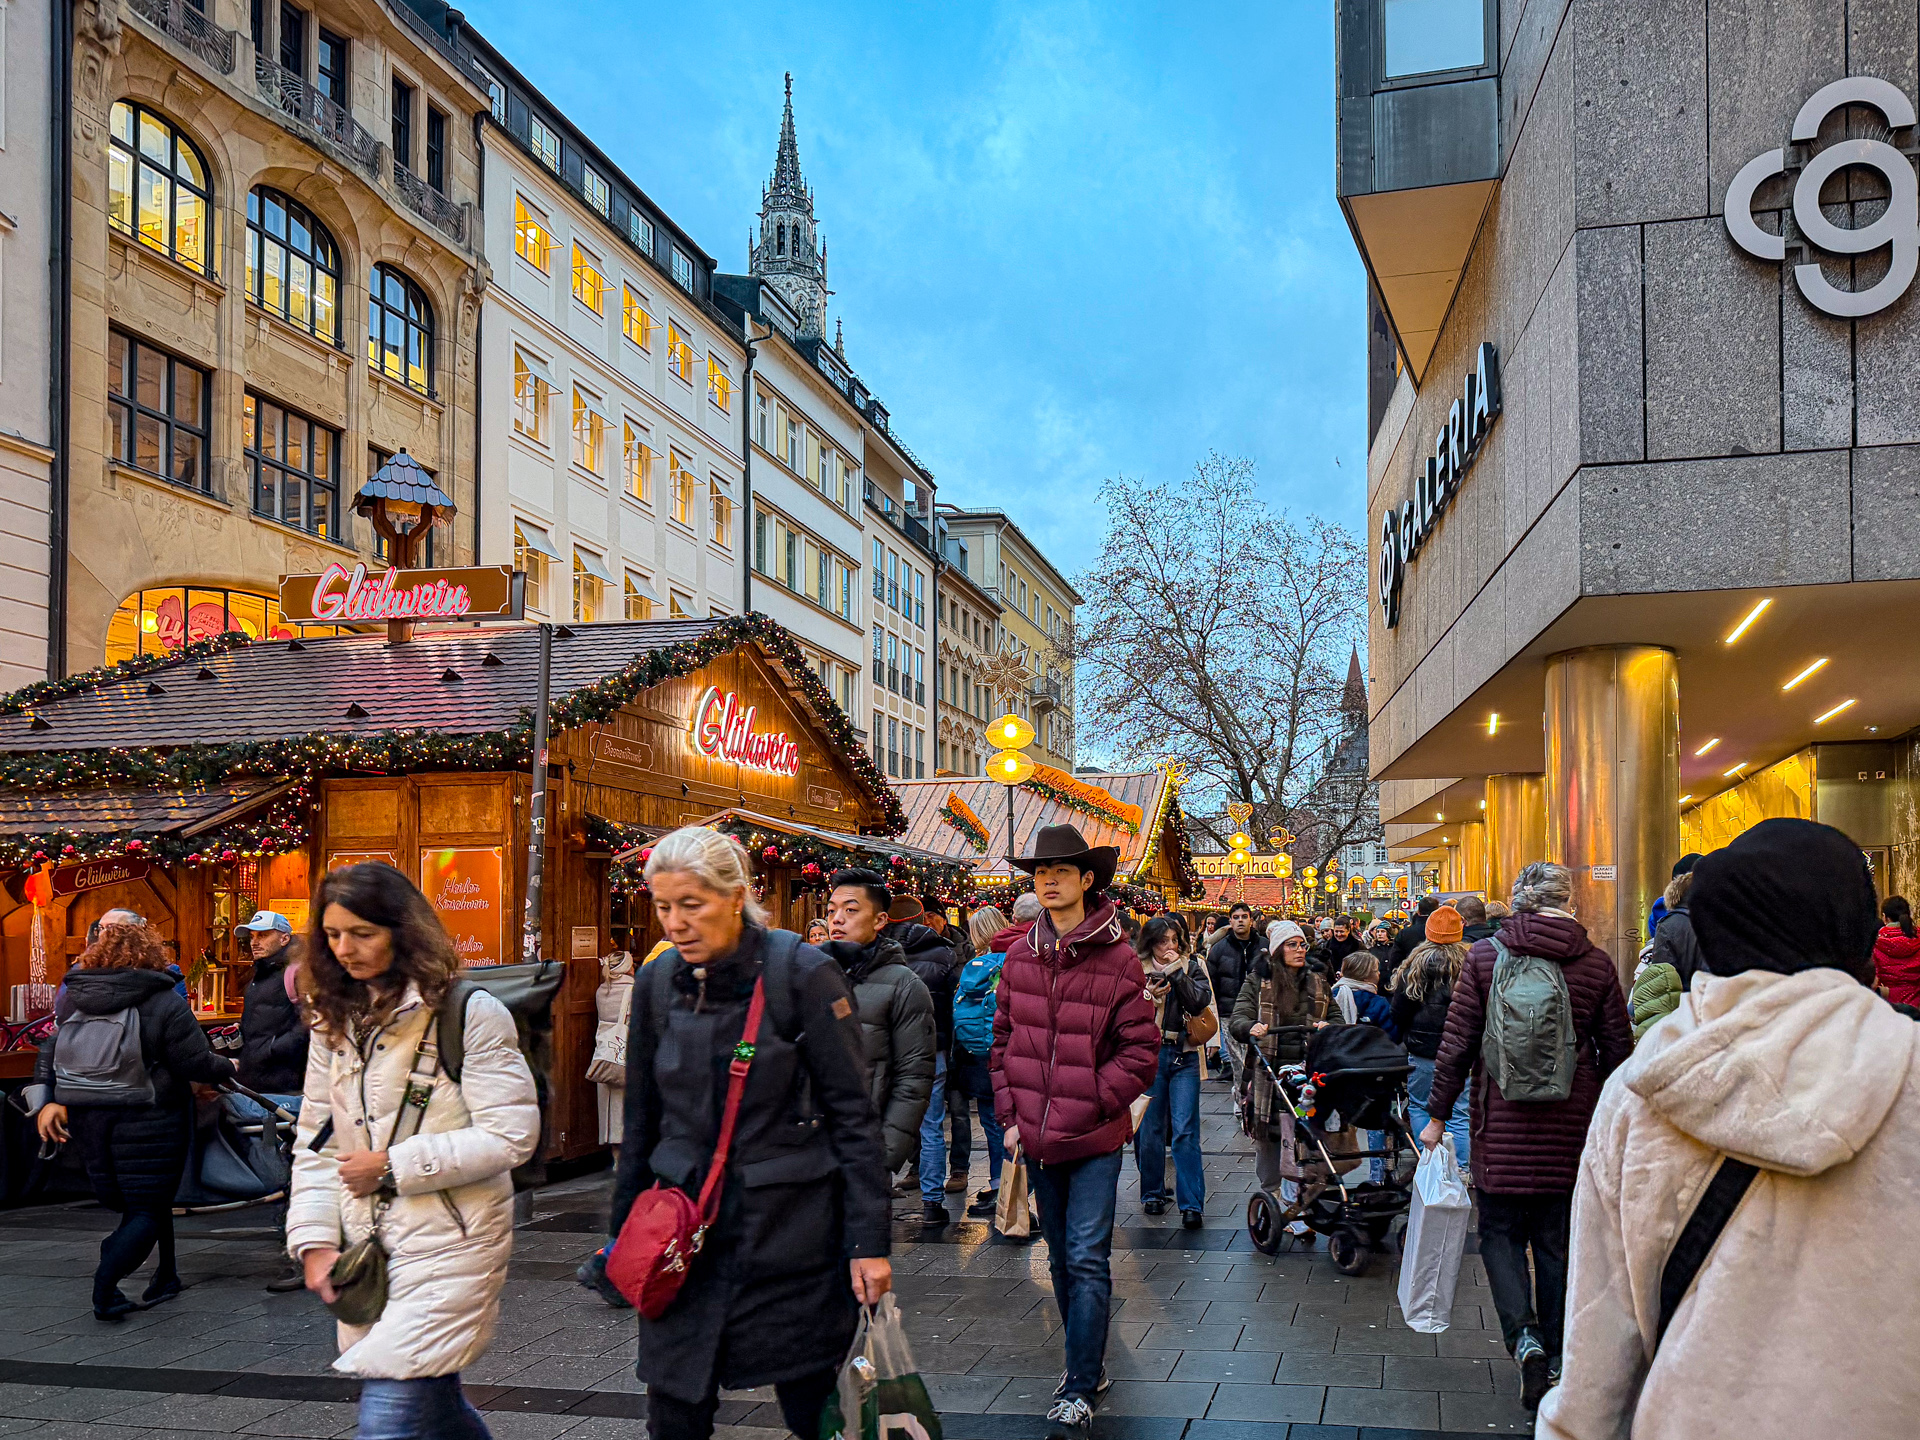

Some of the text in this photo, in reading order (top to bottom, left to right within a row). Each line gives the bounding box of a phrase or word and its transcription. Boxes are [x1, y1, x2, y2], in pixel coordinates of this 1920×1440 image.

[1401, 342, 1497, 564] GALERIA
[311, 562, 472, 620] Glühwein
[694, 685, 799, 777] Glühwein
[75, 866, 130, 888] Glühwein
